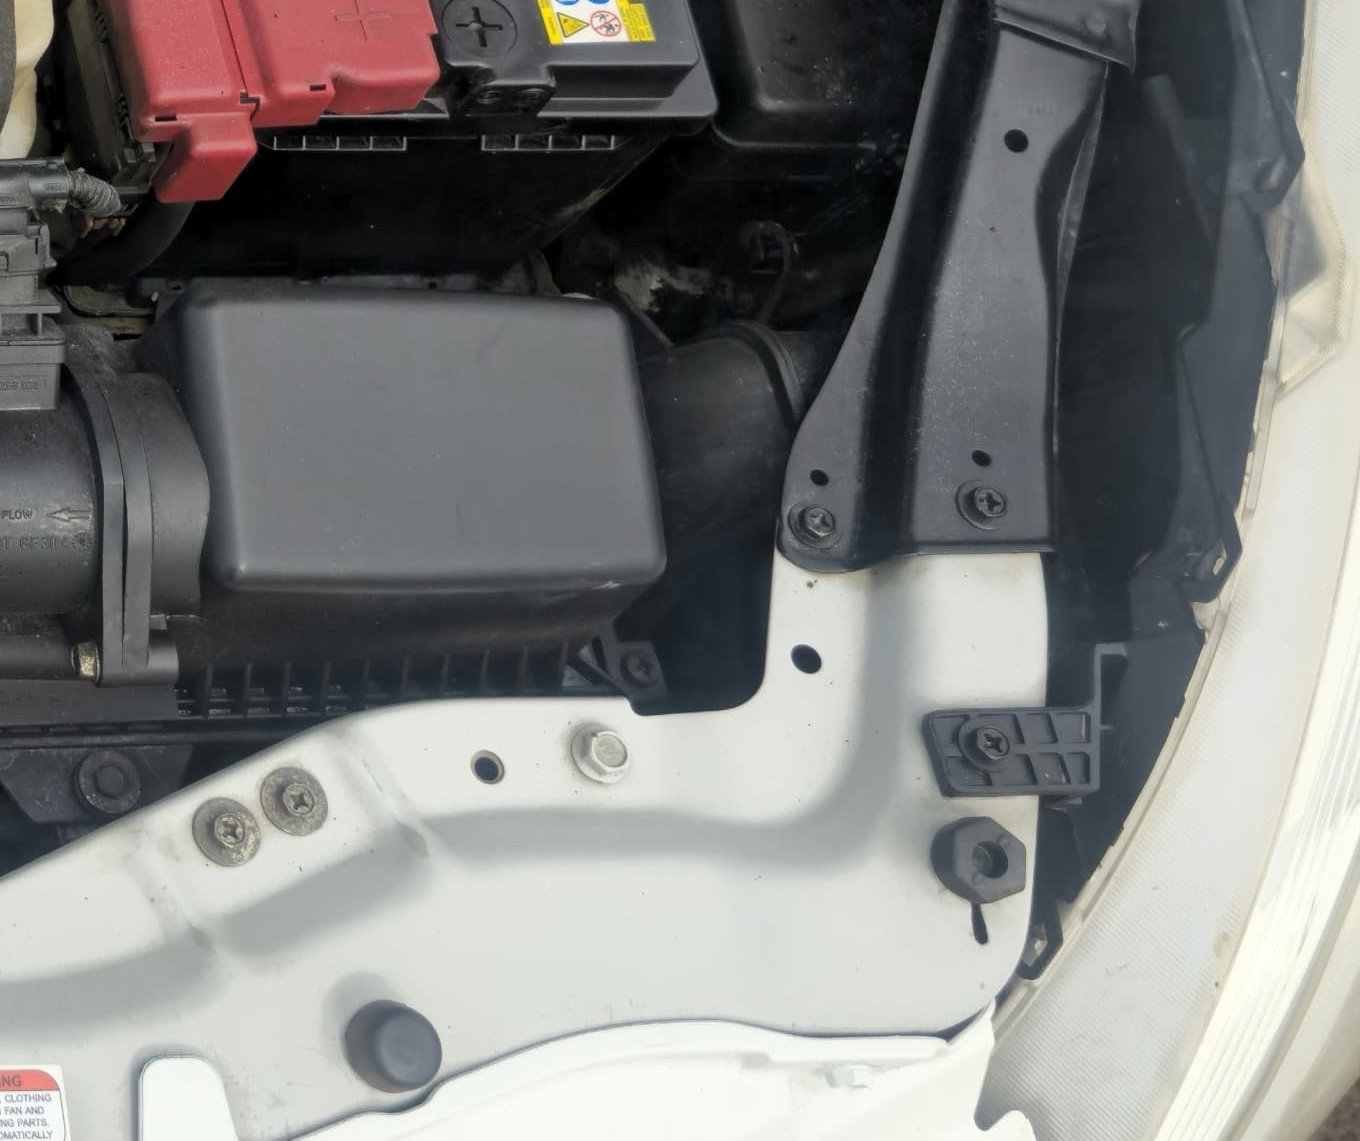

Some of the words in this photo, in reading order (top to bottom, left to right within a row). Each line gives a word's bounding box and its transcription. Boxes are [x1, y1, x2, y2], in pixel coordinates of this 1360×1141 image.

[0, 510, 33, 520] FLOW
[5, 1093, 52, 1103] CLOTHING
[4, 1106, 22, 1115] FAN
[25, 1105, 45, 1115] AND
[17, 1117, 49, 1127] PARTS.
